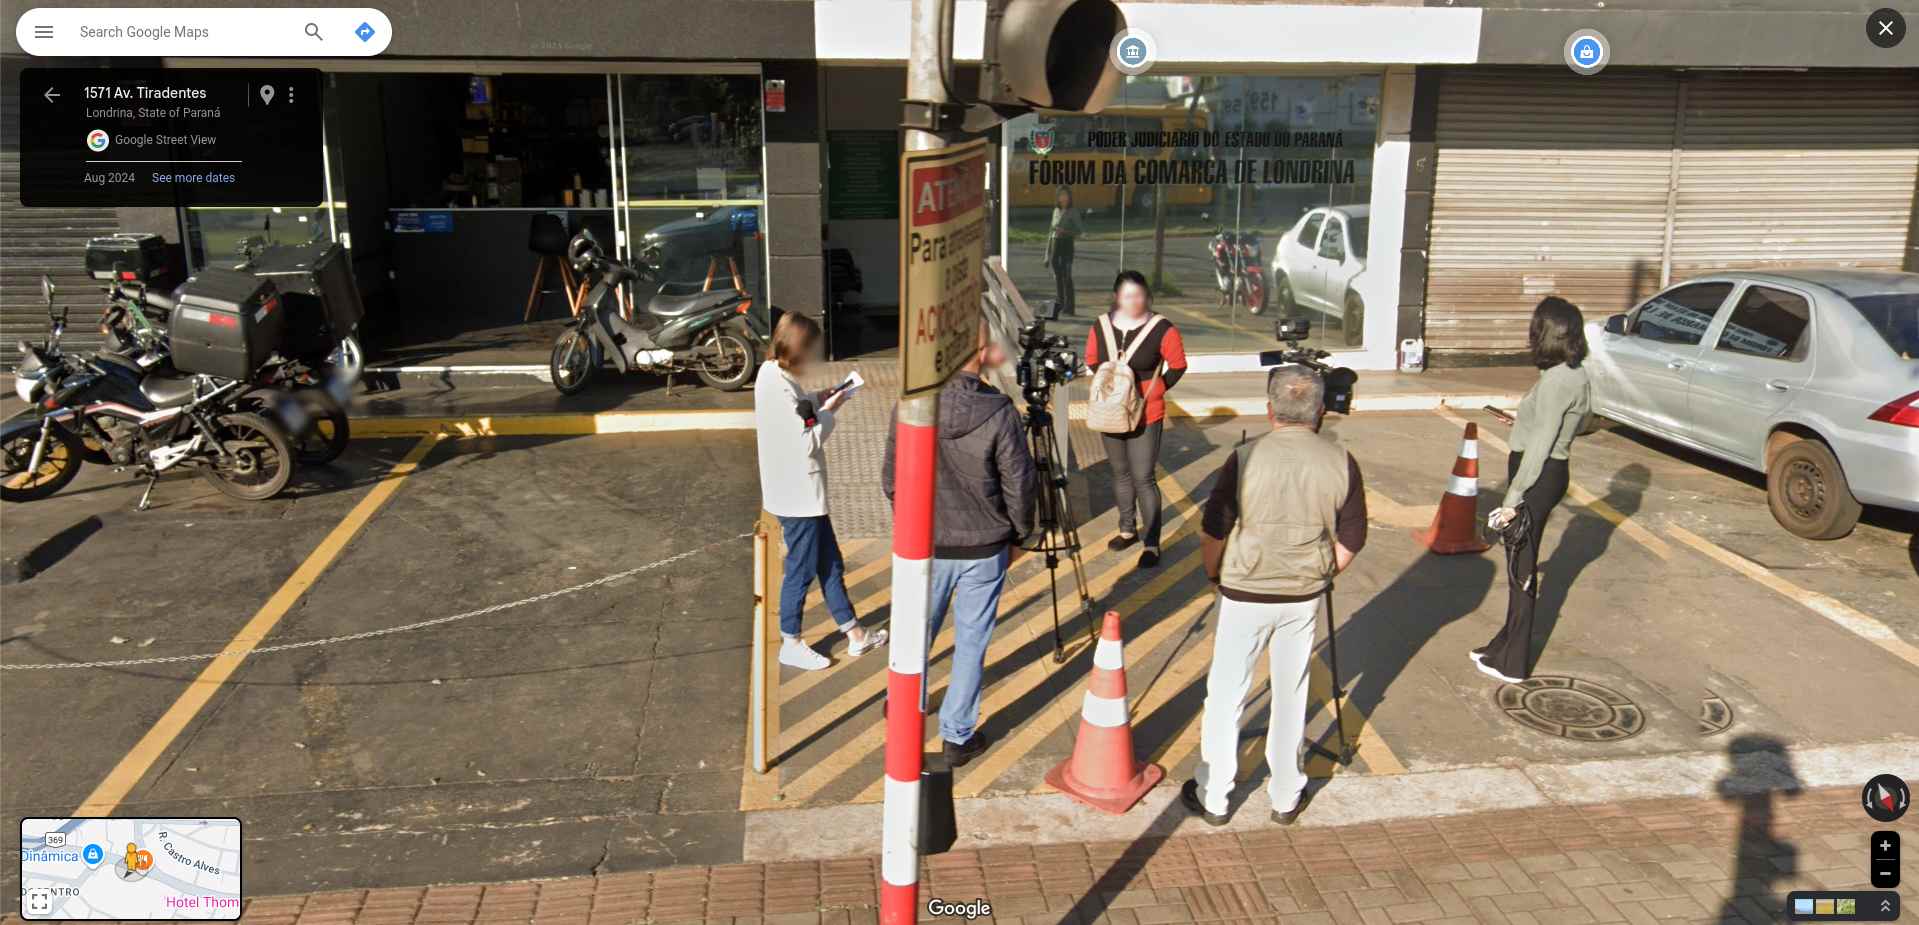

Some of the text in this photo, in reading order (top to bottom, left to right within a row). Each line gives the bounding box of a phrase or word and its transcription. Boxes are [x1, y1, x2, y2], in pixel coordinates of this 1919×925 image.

[1088, 130, 1126, 148] PODER
[1203, 130, 1220, 148] DO
[1225, 130, 1271, 148] ESTADO
[1273, 130, 1291, 148] DO
[1294, 128, 1343, 148] PARANÁ
[1029, 155, 1355, 185] FÓRUM DA COMARCA DE LONDRINA
[910, 232, 946, 264] Para
